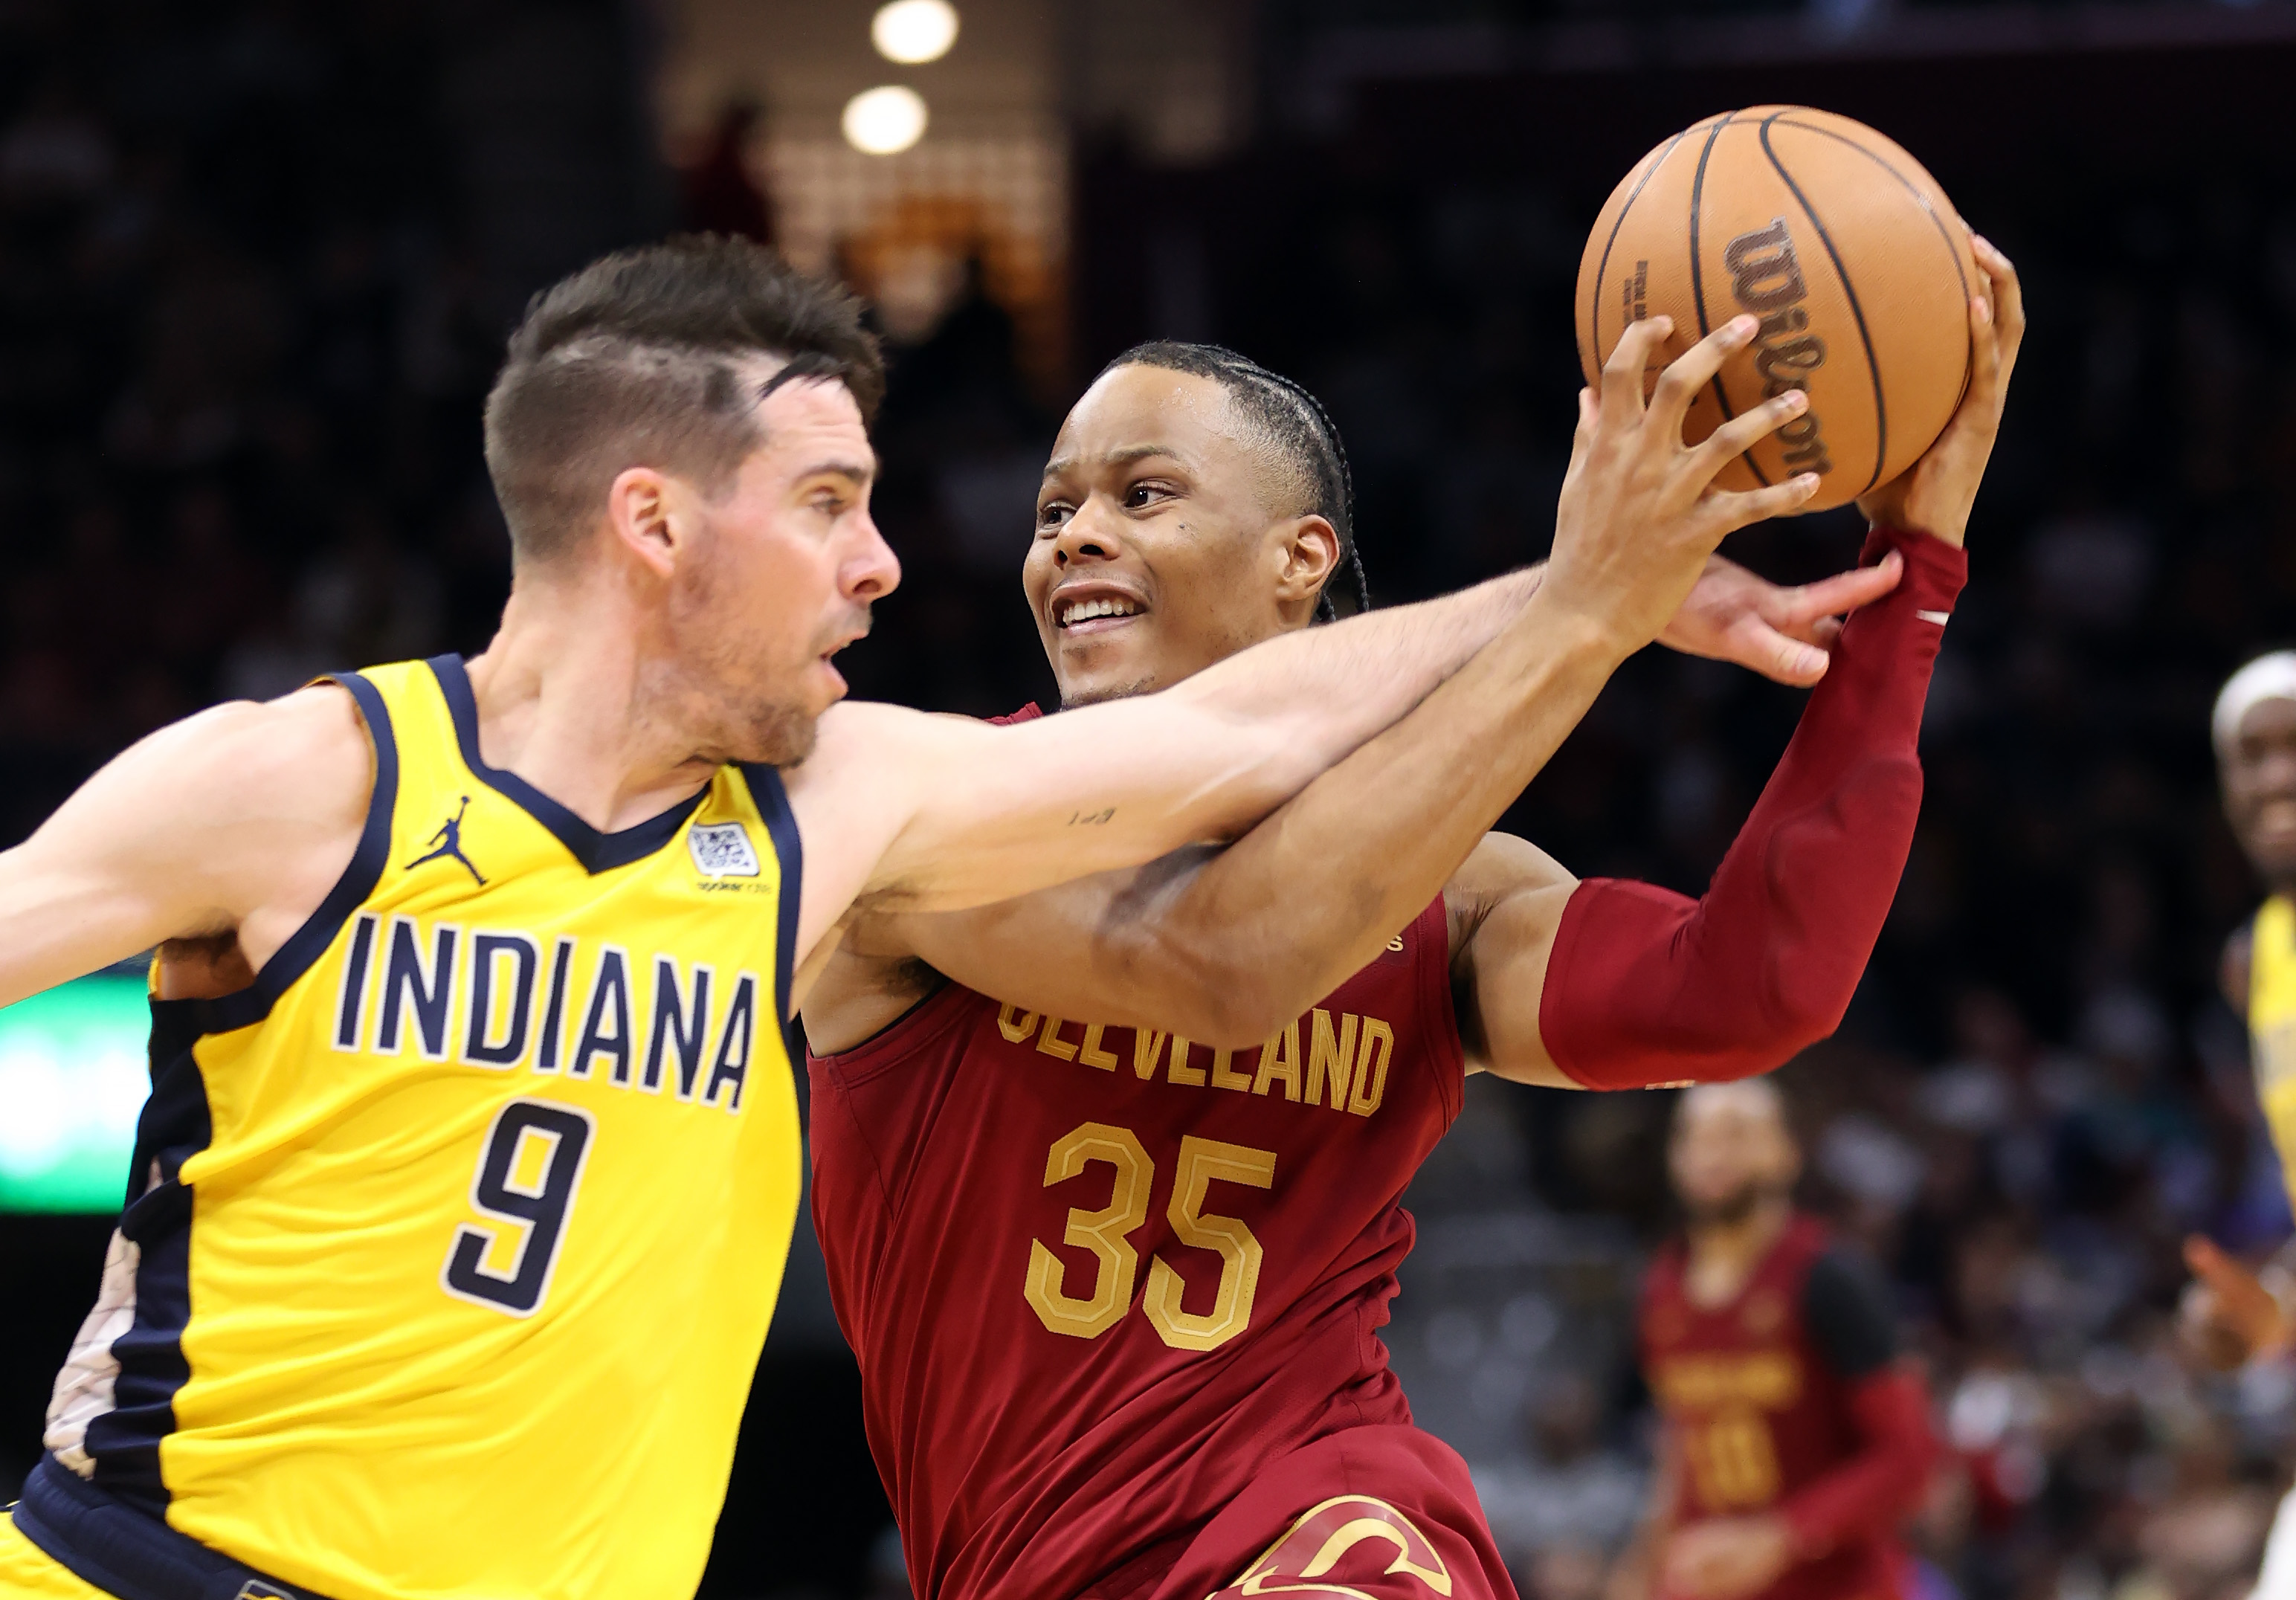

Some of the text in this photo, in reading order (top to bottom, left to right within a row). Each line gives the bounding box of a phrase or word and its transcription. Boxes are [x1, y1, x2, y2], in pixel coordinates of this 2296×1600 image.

[332, 911, 759, 1117] INDIANA
[440, 1096, 596, 1320] 9
[1024, 1120, 1277, 1352] 35
